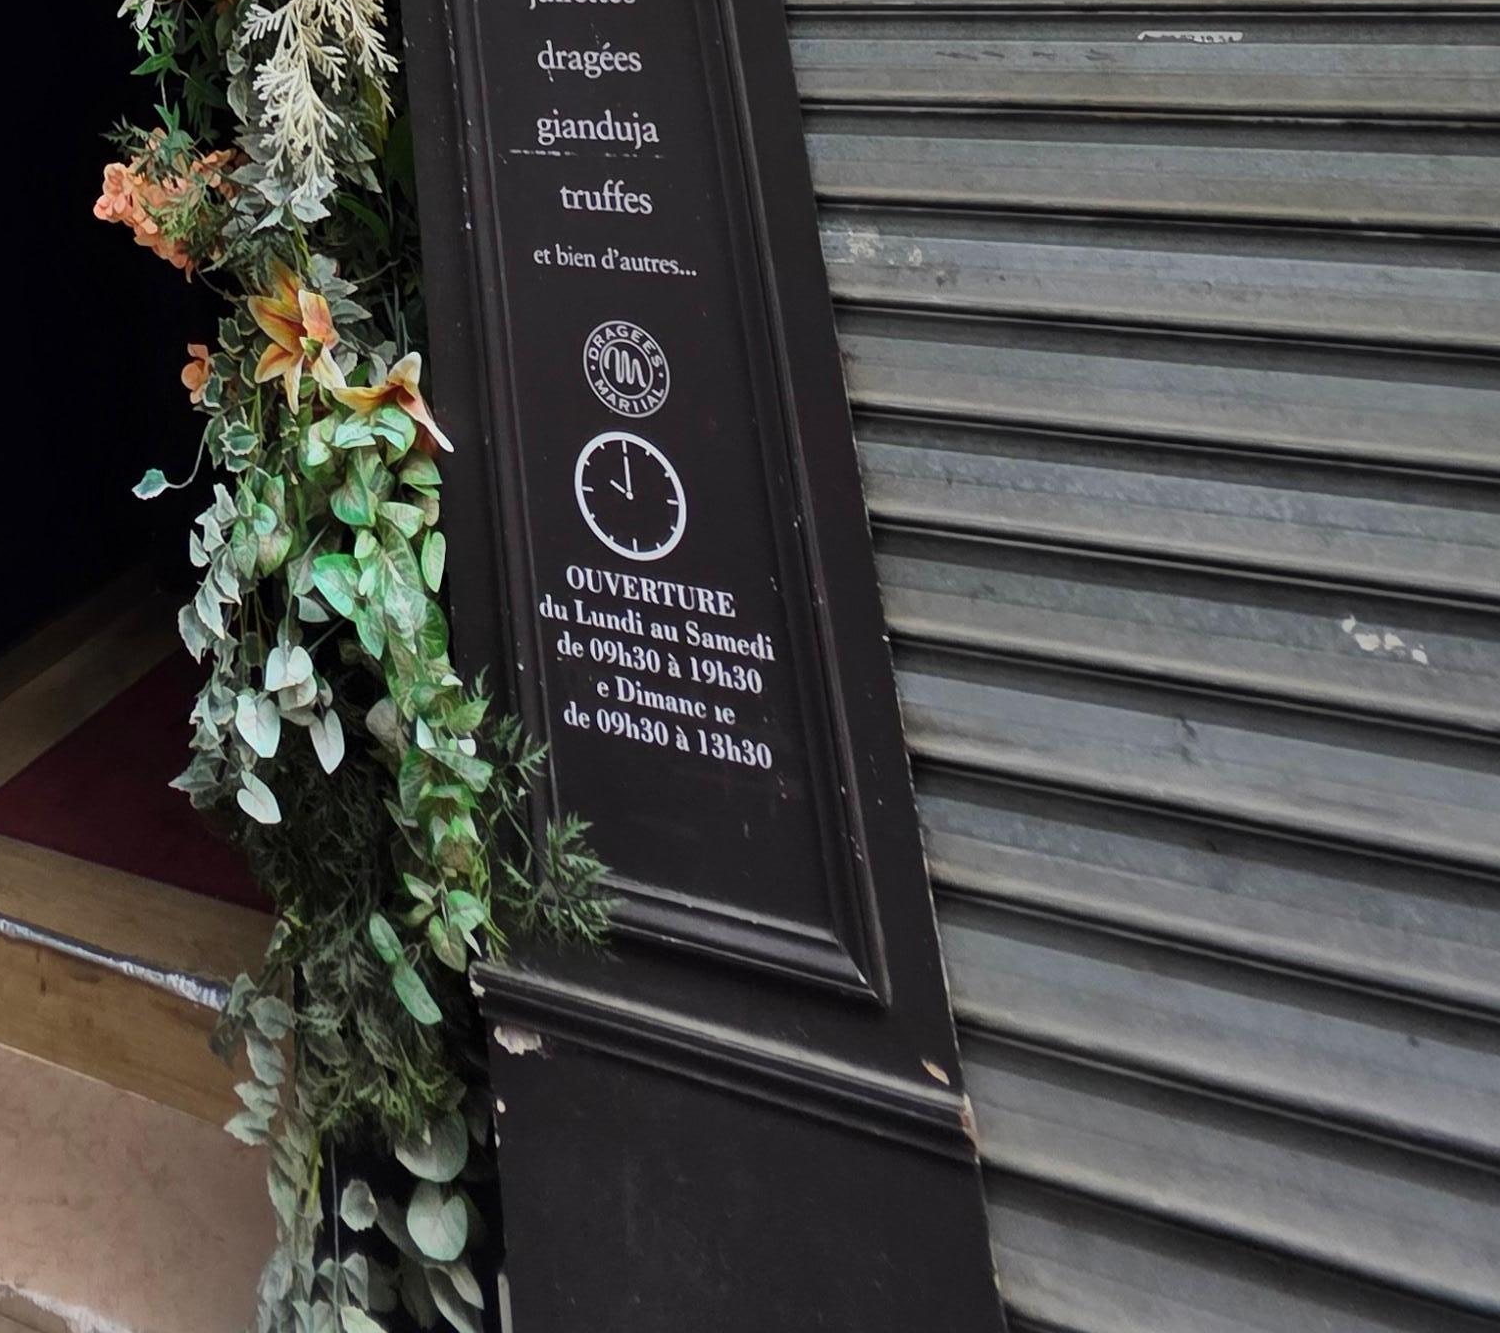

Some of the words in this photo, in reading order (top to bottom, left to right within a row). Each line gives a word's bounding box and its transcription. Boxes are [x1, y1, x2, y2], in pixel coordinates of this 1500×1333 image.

[537, 40, 642, 78] dragées
[536, 109, 659, 149] gianduja
[560, 180, 653, 214] truffes
[533, 248, 551, 265] et
[556, 244, 597, 268] bien
[588, 325, 663, 368] DRAGEES
[566, 565, 736, 618] OUVERTURE
[539, 594, 569, 621] du
[574, 599, 644, 635] Lundi
[650, 622, 679, 642] au
[685, 620, 776, 661] Samedi
[557, 631, 584, 657] de
[589, 637, 660, 673] 09h30
[667, 653, 682, 678] à
[690, 656, 763, 694] 19h30
[563, 701, 590, 729] de
[596, 708, 668, 746] 09h30
[675, 725, 690, 752] à
[698, 729, 772, 769] 13h30
